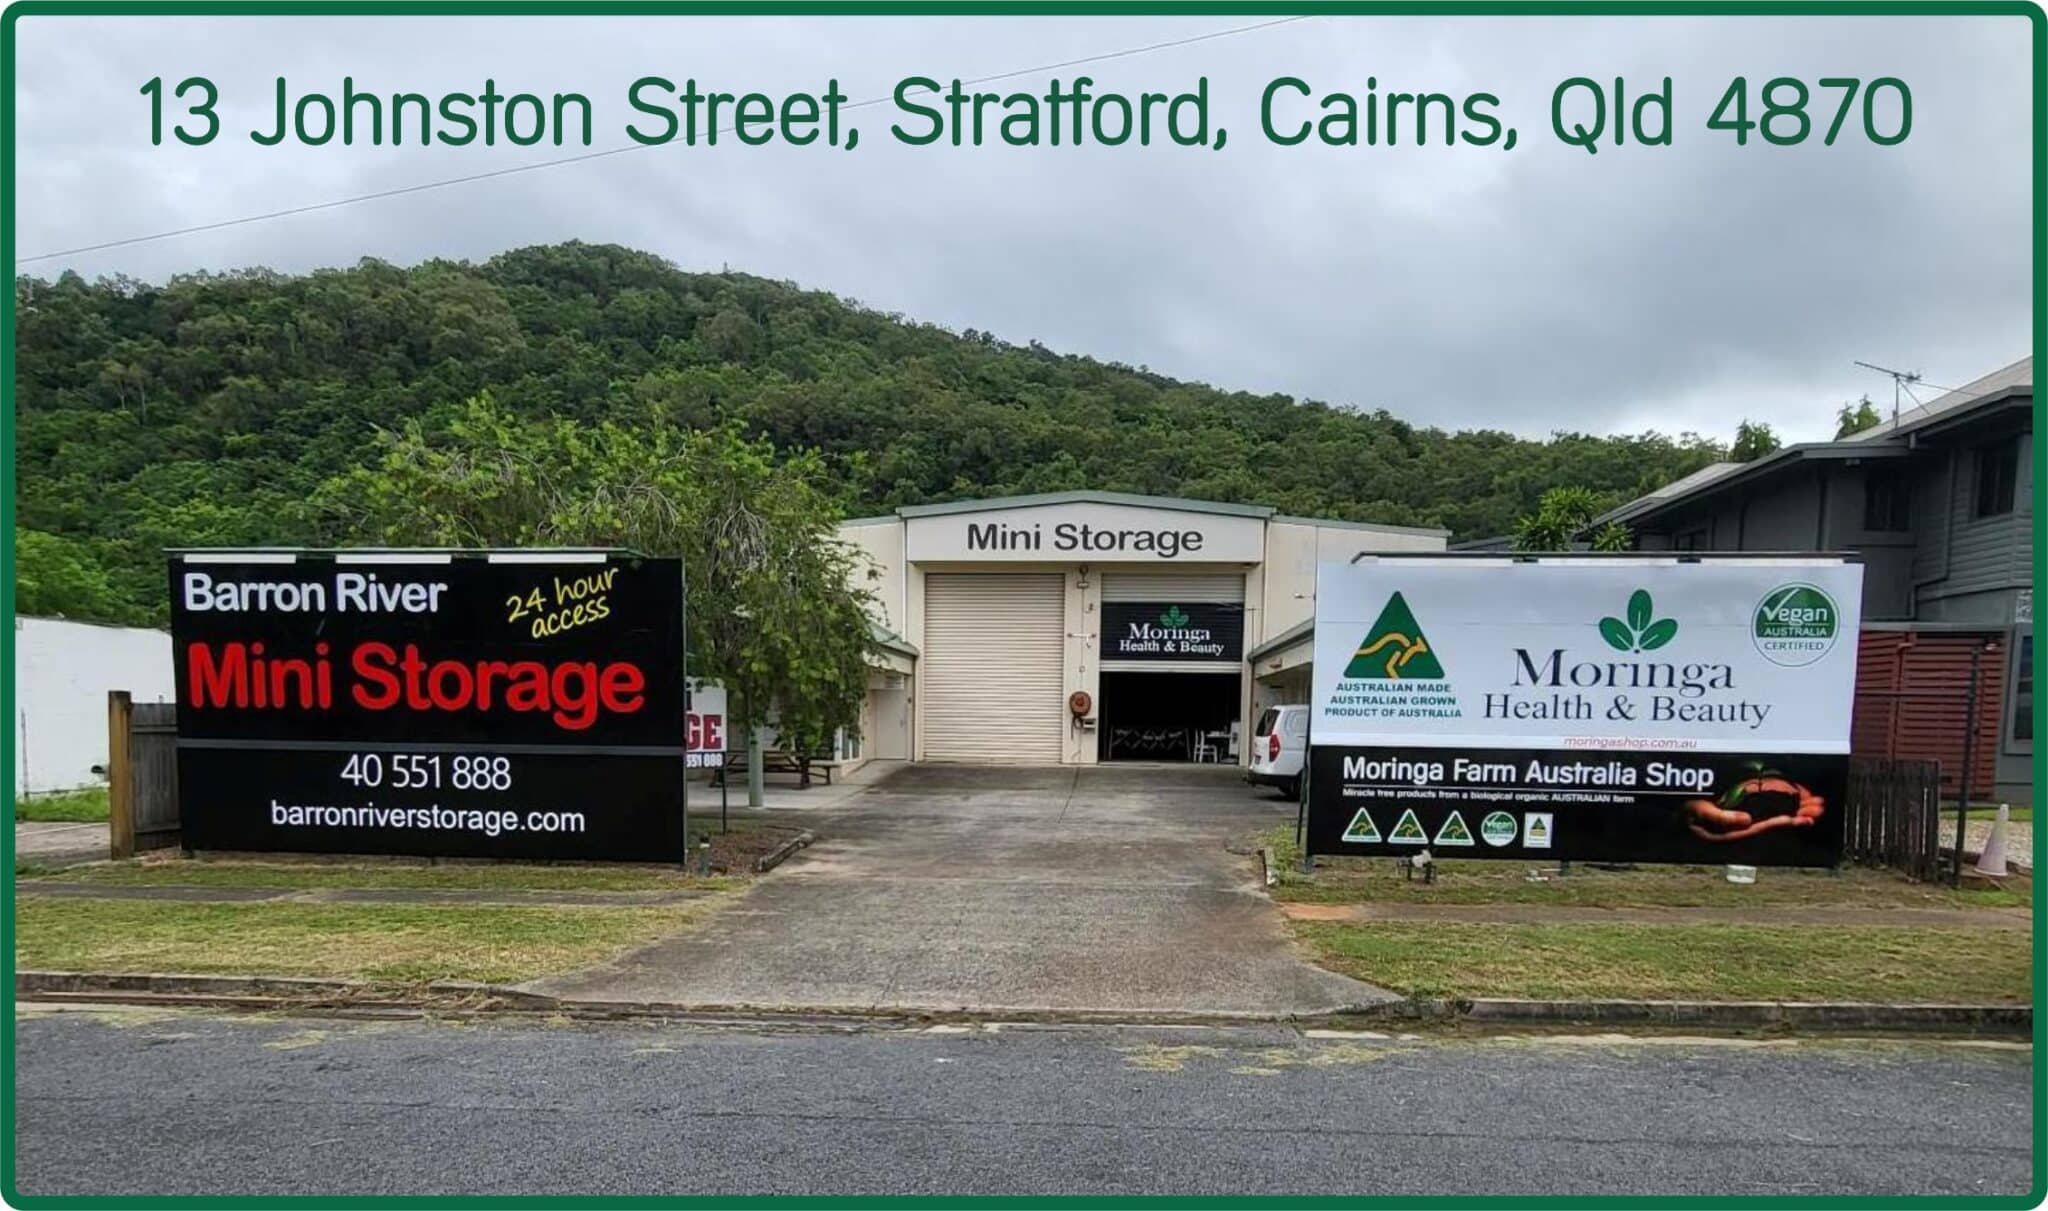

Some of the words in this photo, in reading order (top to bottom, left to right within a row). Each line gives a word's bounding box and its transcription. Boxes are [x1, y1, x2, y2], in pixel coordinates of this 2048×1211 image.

[968, 524, 1040, 550] Mini
[1054, 523, 1203, 558] Storage
[185, 573, 325, 611] Barron
[337, 574, 447, 612] River
[506, 587, 547, 622] 24
[554, 567, 619, 605] hour
[1763, 592, 1828, 626] Vegan
[532, 596, 610, 638] access
[1129, 623, 1211, 642] Moringa
[1764, 627, 1827, 636] AUSTRALIA
[1120, 639, 1160, 652] Health
[1164, 640, 1176, 652] &
[1180, 641, 1225, 656] Beauty
[1764, 642, 1824, 651] CERTIFIED
[188, 642, 332, 708] Mini
[352, 642, 645, 730] Storage
[1336, 682, 1413, 692] AUSTRALIAN
[1417, 683, 1451, 693] MADE
[1510, 649, 1735, 698] Moringa
[1325, 707, 1378, 717] PRODUCT
[1381, 708, 1397, 718] OF
[1399, 708, 1462, 718] AUSTRALIA
[1330, 695, 1407, 705] AUSTRALIAN
[1411, 696, 1456, 706] GROWN
[1483, 693, 1592, 719] Health
[1606, 695, 1637, 720] &
[1652, 696, 1772, 729] Beauty
[1564, 736, 1698, 749] moringashop.com.au
[341, 754, 382, 786] 40
[392, 754, 441, 788] 551
[453, 756, 511, 790] 888
[1343, 757, 1443, 785] Moringa
[1453, 760, 1516, 782] Farm
[1525, 761, 1637, 785] Australia
[1646, 763, 1714, 791] Shop
[1397, 790, 1436, 799] products
[1438, 790, 1459, 799] from
[1470, 791, 1514, 801] biological
[1515, 794, 1550, 802] organic
[1551, 793, 1611, 802] AUSTRALIAN
[1612, 795, 1635, 803] farm
[272, 800, 584, 836] barronriverstorage.com
